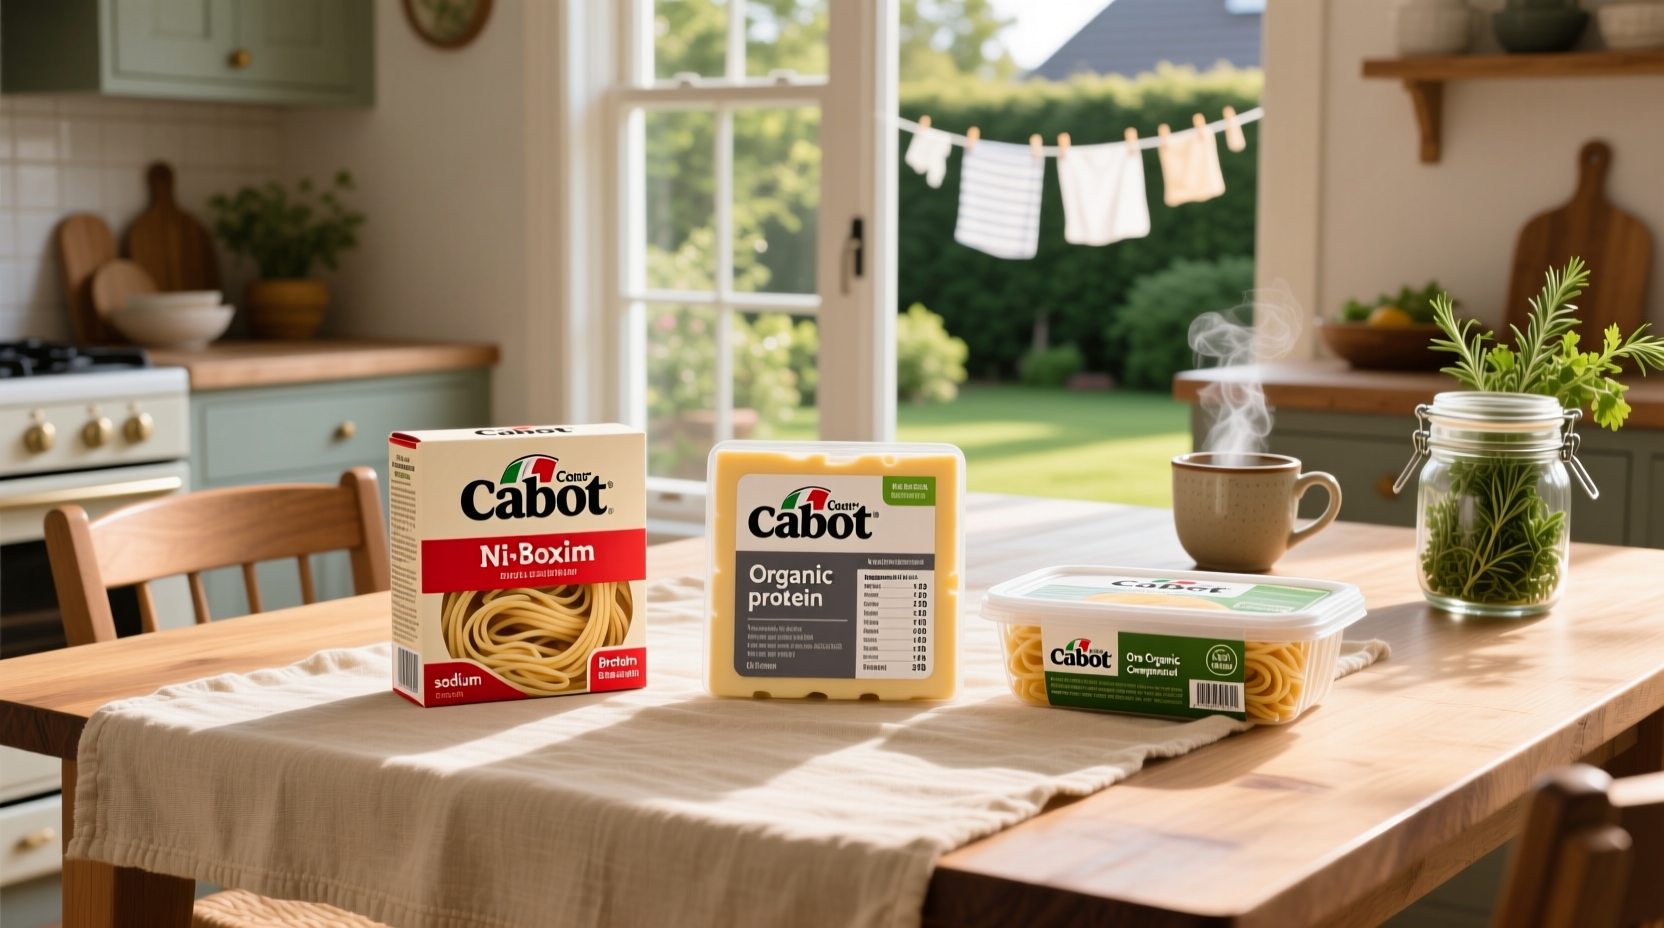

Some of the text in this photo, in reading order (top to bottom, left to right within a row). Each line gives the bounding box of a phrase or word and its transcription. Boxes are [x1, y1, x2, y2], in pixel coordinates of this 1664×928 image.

[460, 475, 608, 521] Cabot
[748, 503, 873, 540] Cabot
[749, 564, 834, 590] Organic
[748, 588, 823, 612] protein
[1050, 647, 1112, 669] Cabot
[434, 672, 482, 689] sodium
